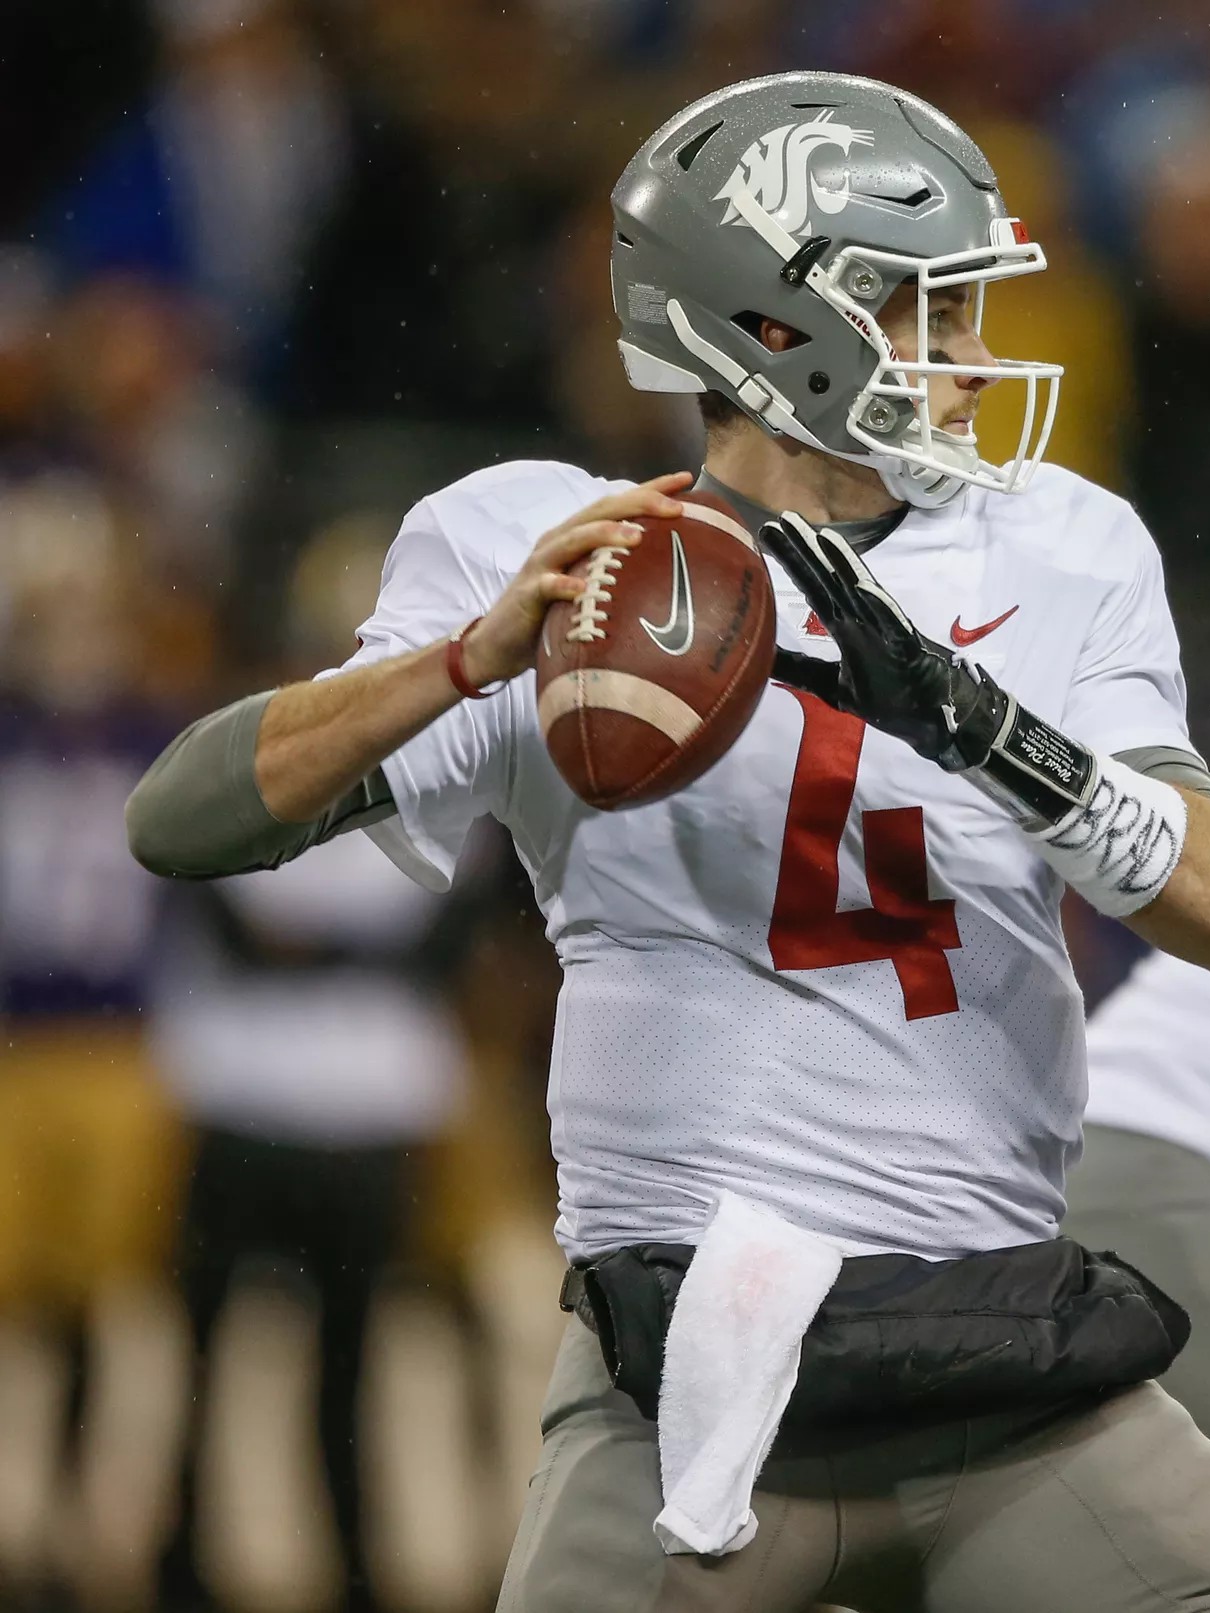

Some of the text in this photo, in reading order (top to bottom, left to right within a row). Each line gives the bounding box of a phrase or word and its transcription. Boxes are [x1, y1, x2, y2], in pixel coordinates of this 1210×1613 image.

[768, 680, 963, 1021] 4
[1020, 740, 1071, 782] Wrist Plan
